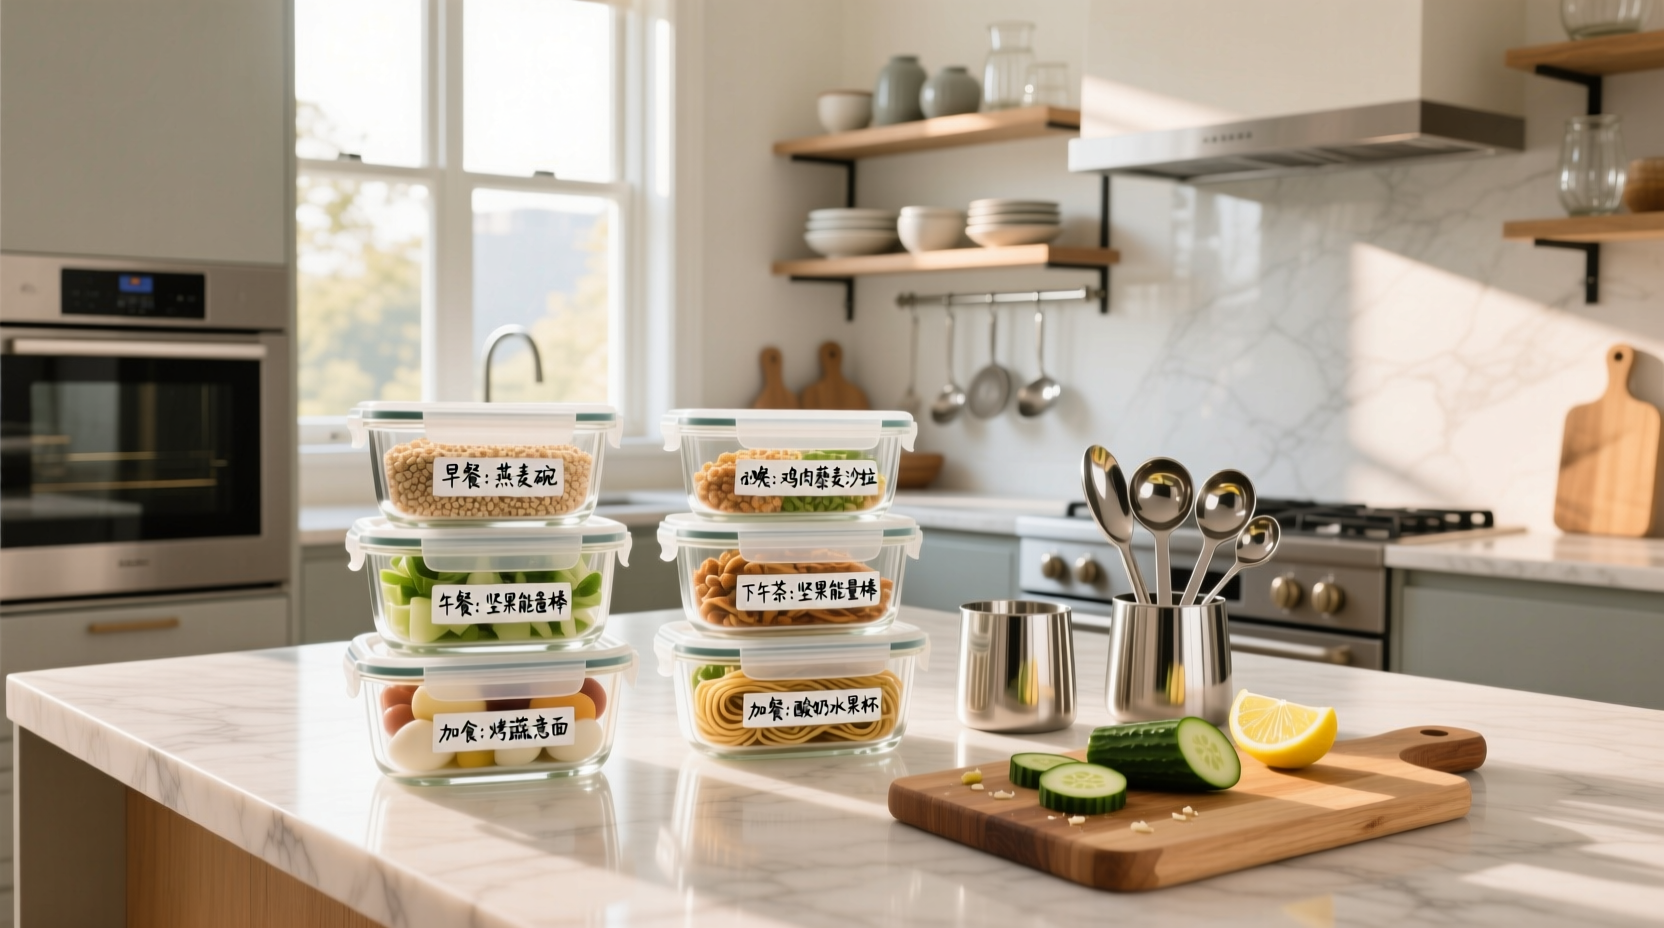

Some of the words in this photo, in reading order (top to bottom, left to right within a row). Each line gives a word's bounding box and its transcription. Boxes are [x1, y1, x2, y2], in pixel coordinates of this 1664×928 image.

[442, 461, 558, 489] 早餐：燕麦碗
[742, 578, 878, 604] 下午茶：坚果能量棒
[748, 695, 879, 722] 加餐：酸奶水果杯
